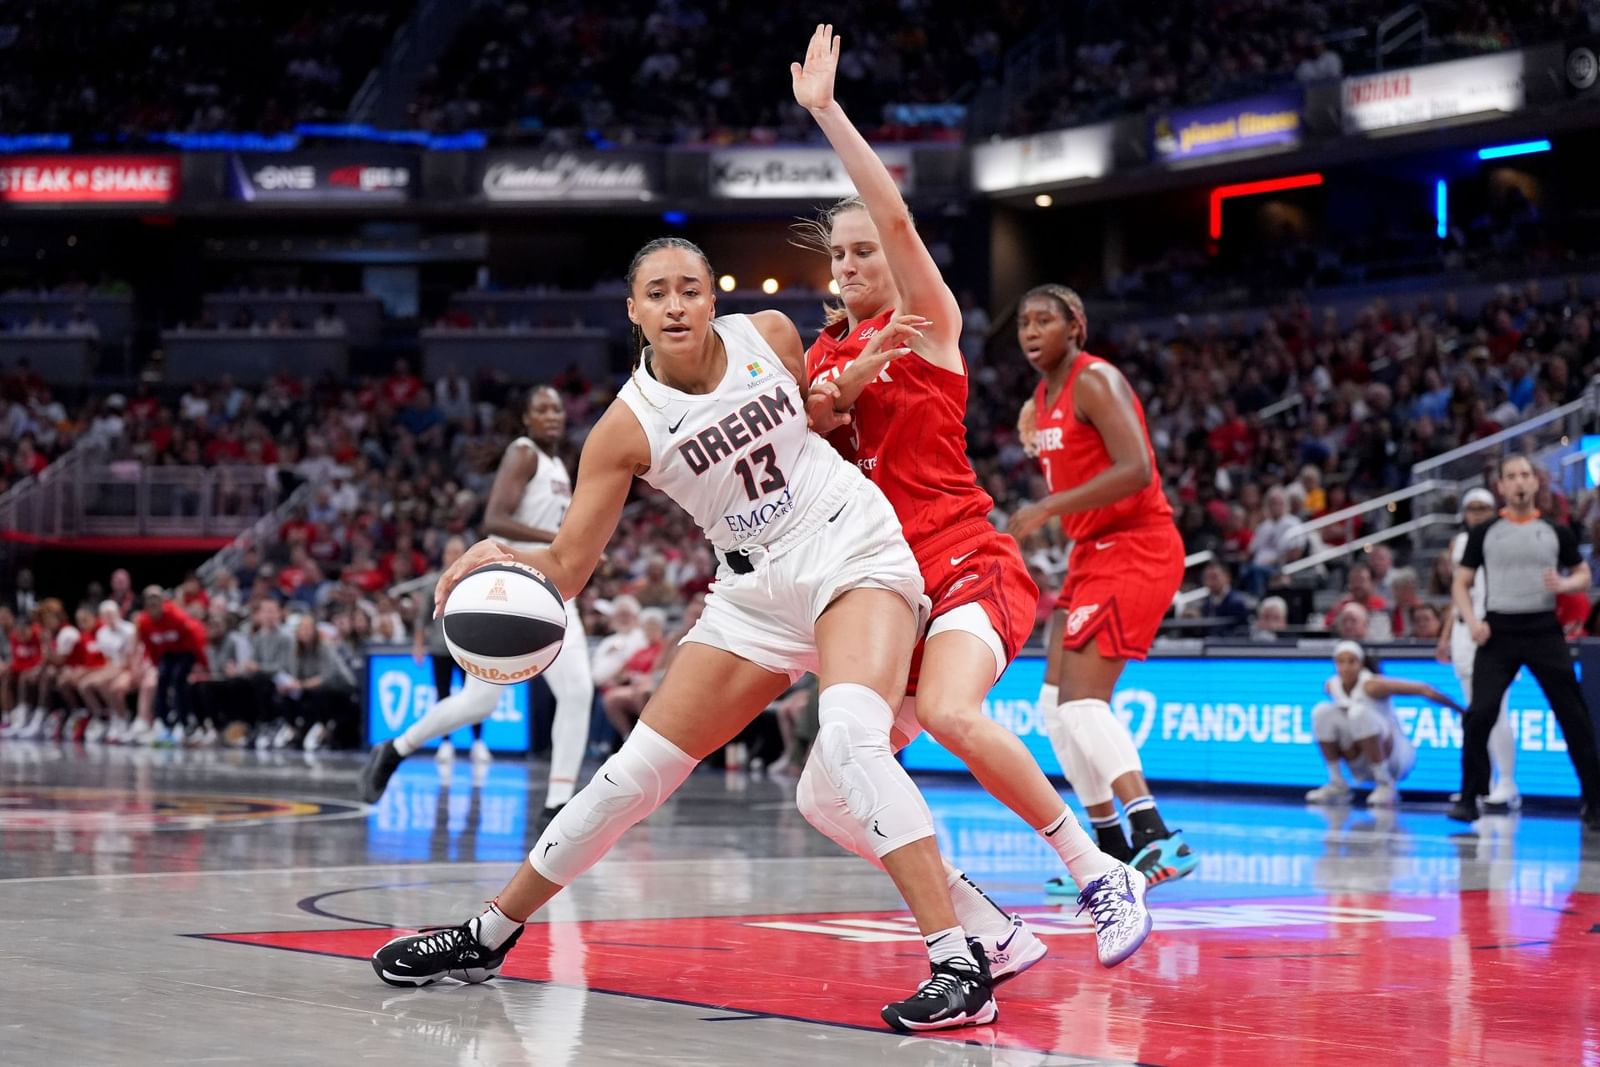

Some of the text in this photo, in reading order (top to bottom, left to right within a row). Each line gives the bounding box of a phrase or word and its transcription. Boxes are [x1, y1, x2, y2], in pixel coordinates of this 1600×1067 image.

[91, 165, 171, 192] SHAKE
[714, 160, 836, 186] KeyBank
[679, 387, 796, 476] DREAM
[735, 443, 787, 502] 13
[458, 655, 538, 680] Wilson
[1162, 702, 1312, 744] FANDUEL
